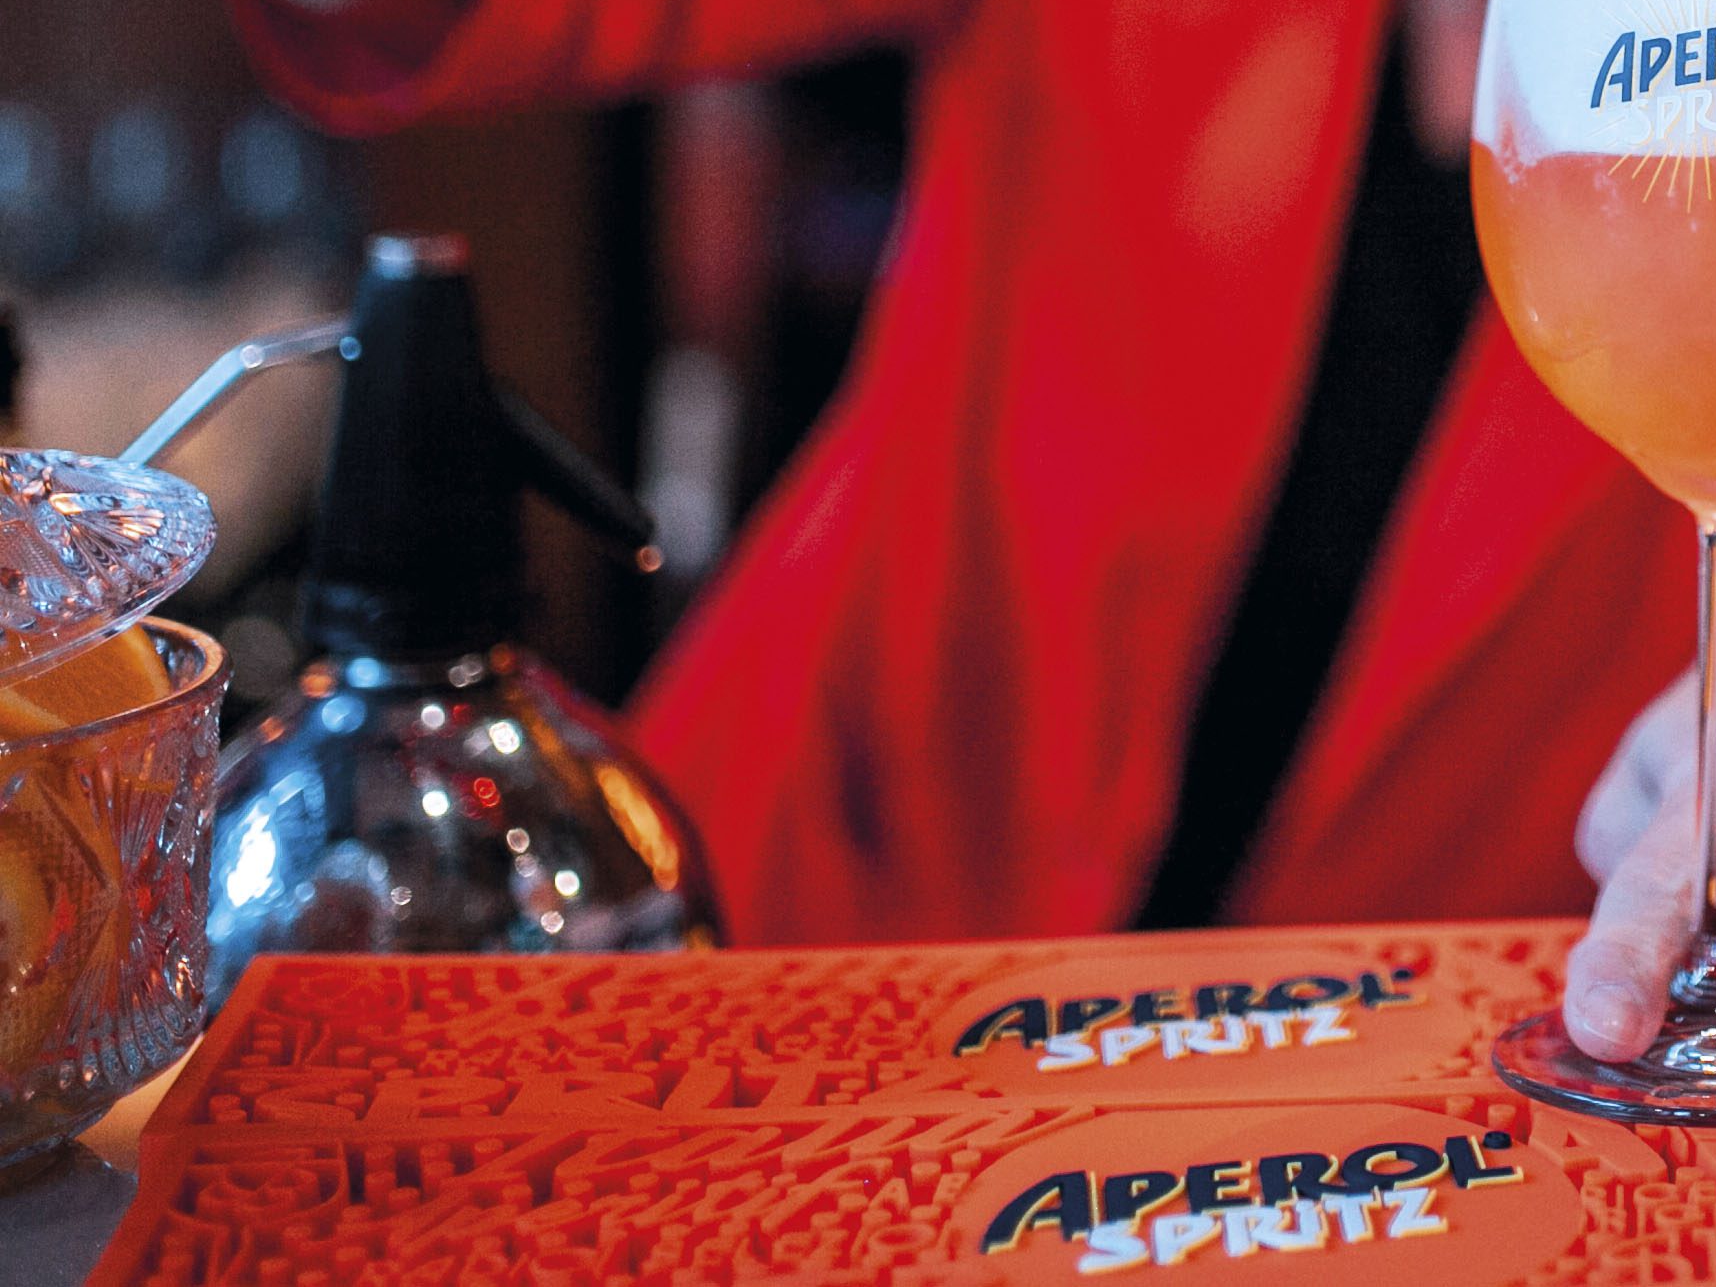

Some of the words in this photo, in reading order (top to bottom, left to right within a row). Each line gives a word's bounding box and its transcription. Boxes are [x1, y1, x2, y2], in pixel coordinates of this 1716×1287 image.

[953, 970, 1413, 1058] APEROL
[979, 1131, 1517, 1255] APEROL
[1076, 1187, 1447, 1273] SPRITZ
